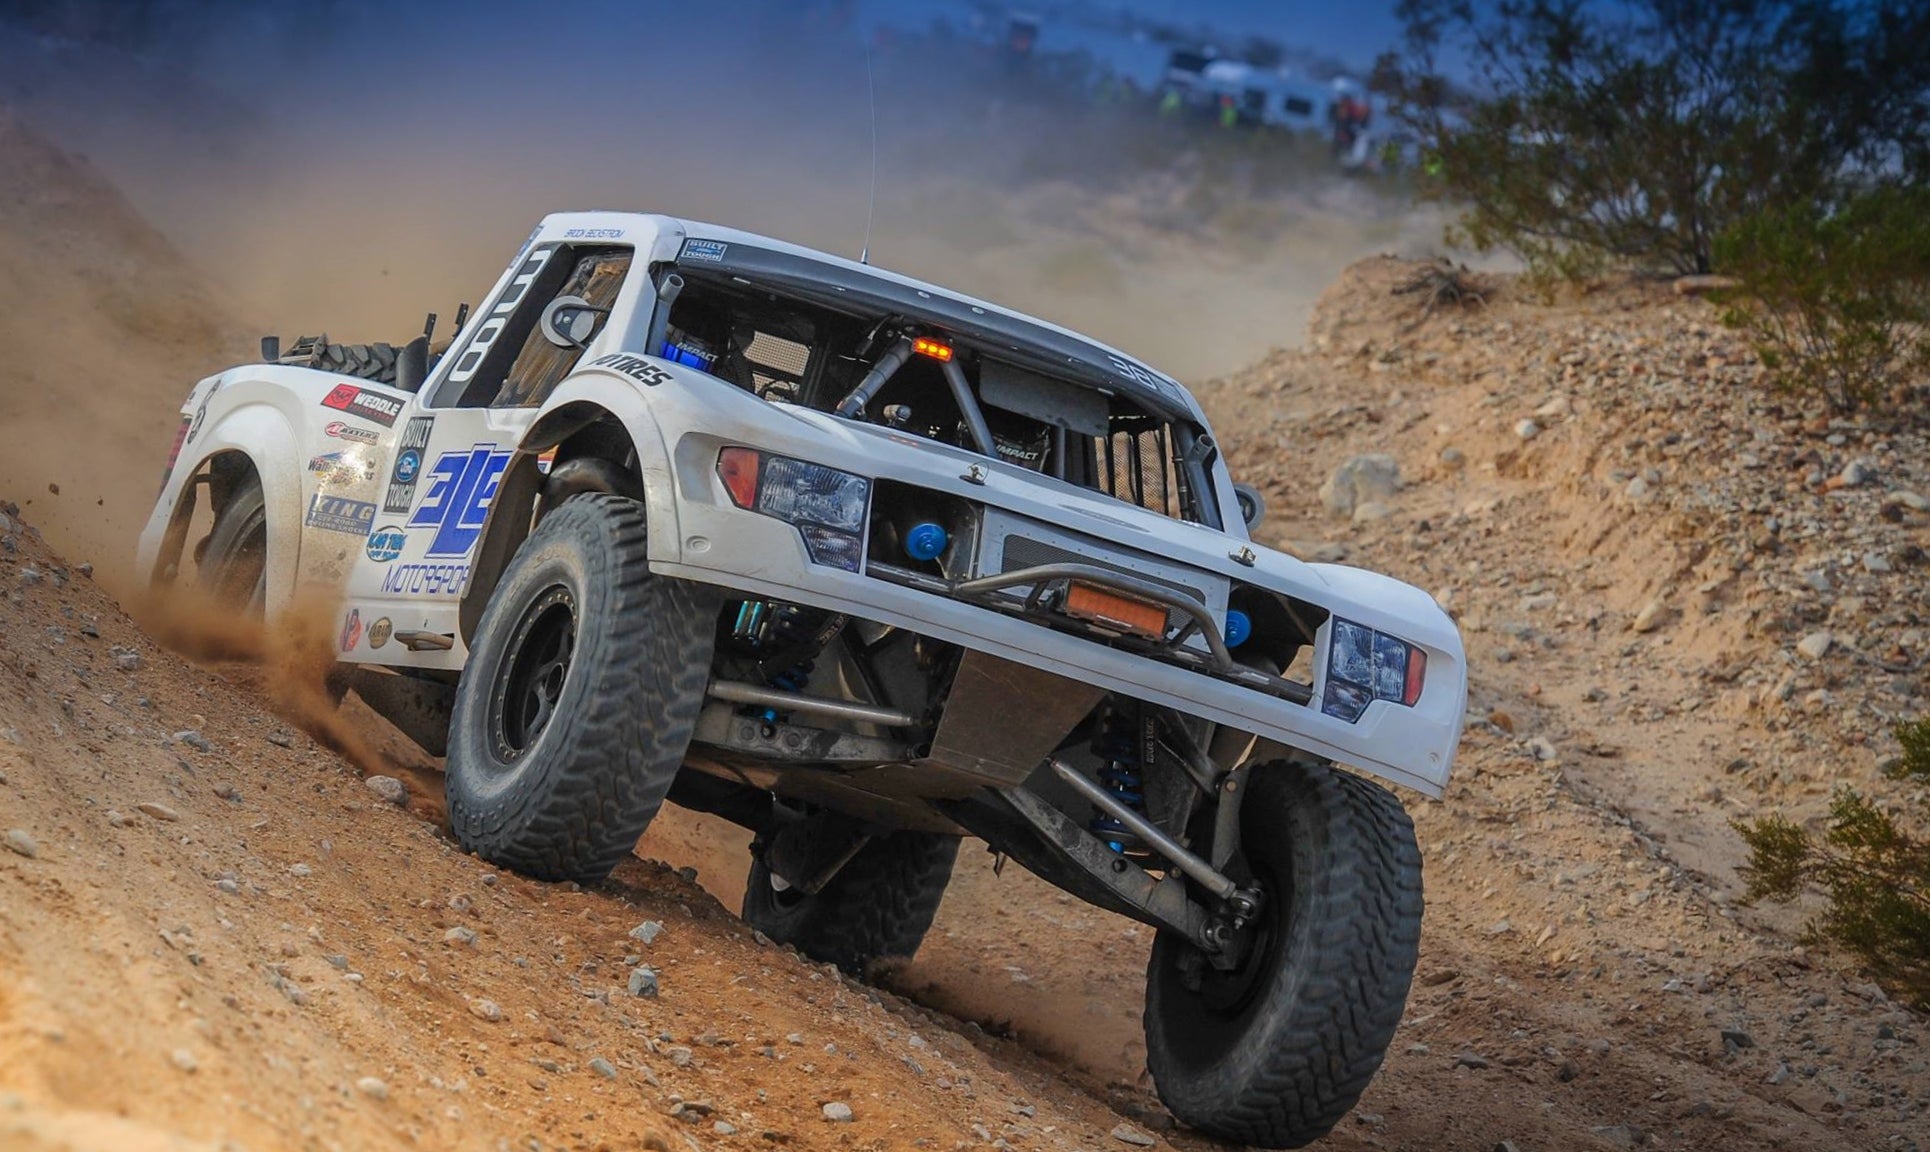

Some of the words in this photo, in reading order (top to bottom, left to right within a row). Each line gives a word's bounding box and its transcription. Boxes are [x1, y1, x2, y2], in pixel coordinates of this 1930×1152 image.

[688, 240, 726, 251] BUILT
[676, 341, 718, 362] IMPACT
[353, 392, 401, 417] WEDDLE
[401, 419, 433, 448] BUILT
[996, 444, 1039, 460] IMPACT
[314, 499, 376, 519] KING
